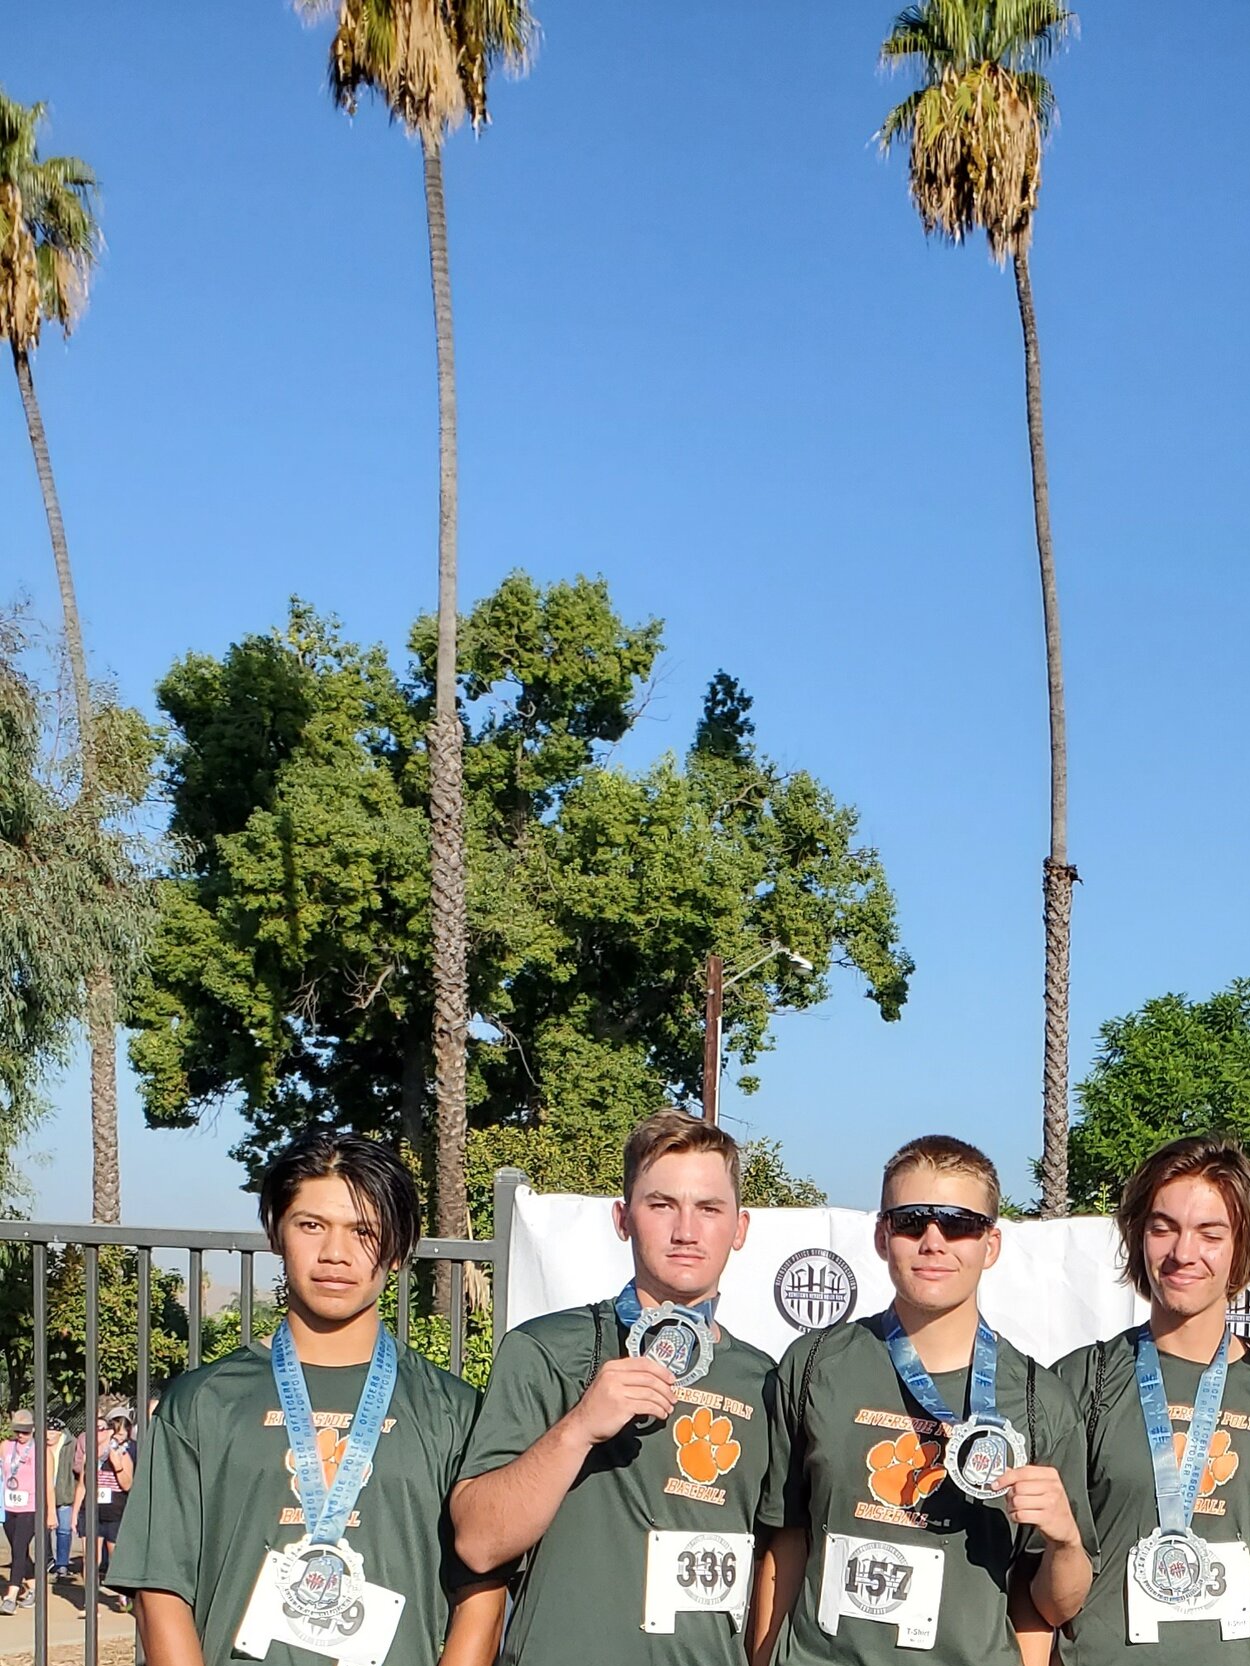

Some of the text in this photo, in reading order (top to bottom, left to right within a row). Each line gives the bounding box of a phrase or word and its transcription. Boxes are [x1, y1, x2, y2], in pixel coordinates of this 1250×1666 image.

[722, 1398, 754, 1420] POLY
[855, 1409, 936, 1434] RIVERSIDE
[664, 1477, 727, 1506] BASEBALL
[855, 1502, 929, 1529] BASEBALL
[677, 1551, 736, 1588] 336
[845, 1557, 914, 1601] 157
[906, 1627, 931, 1638] T-Shirt
